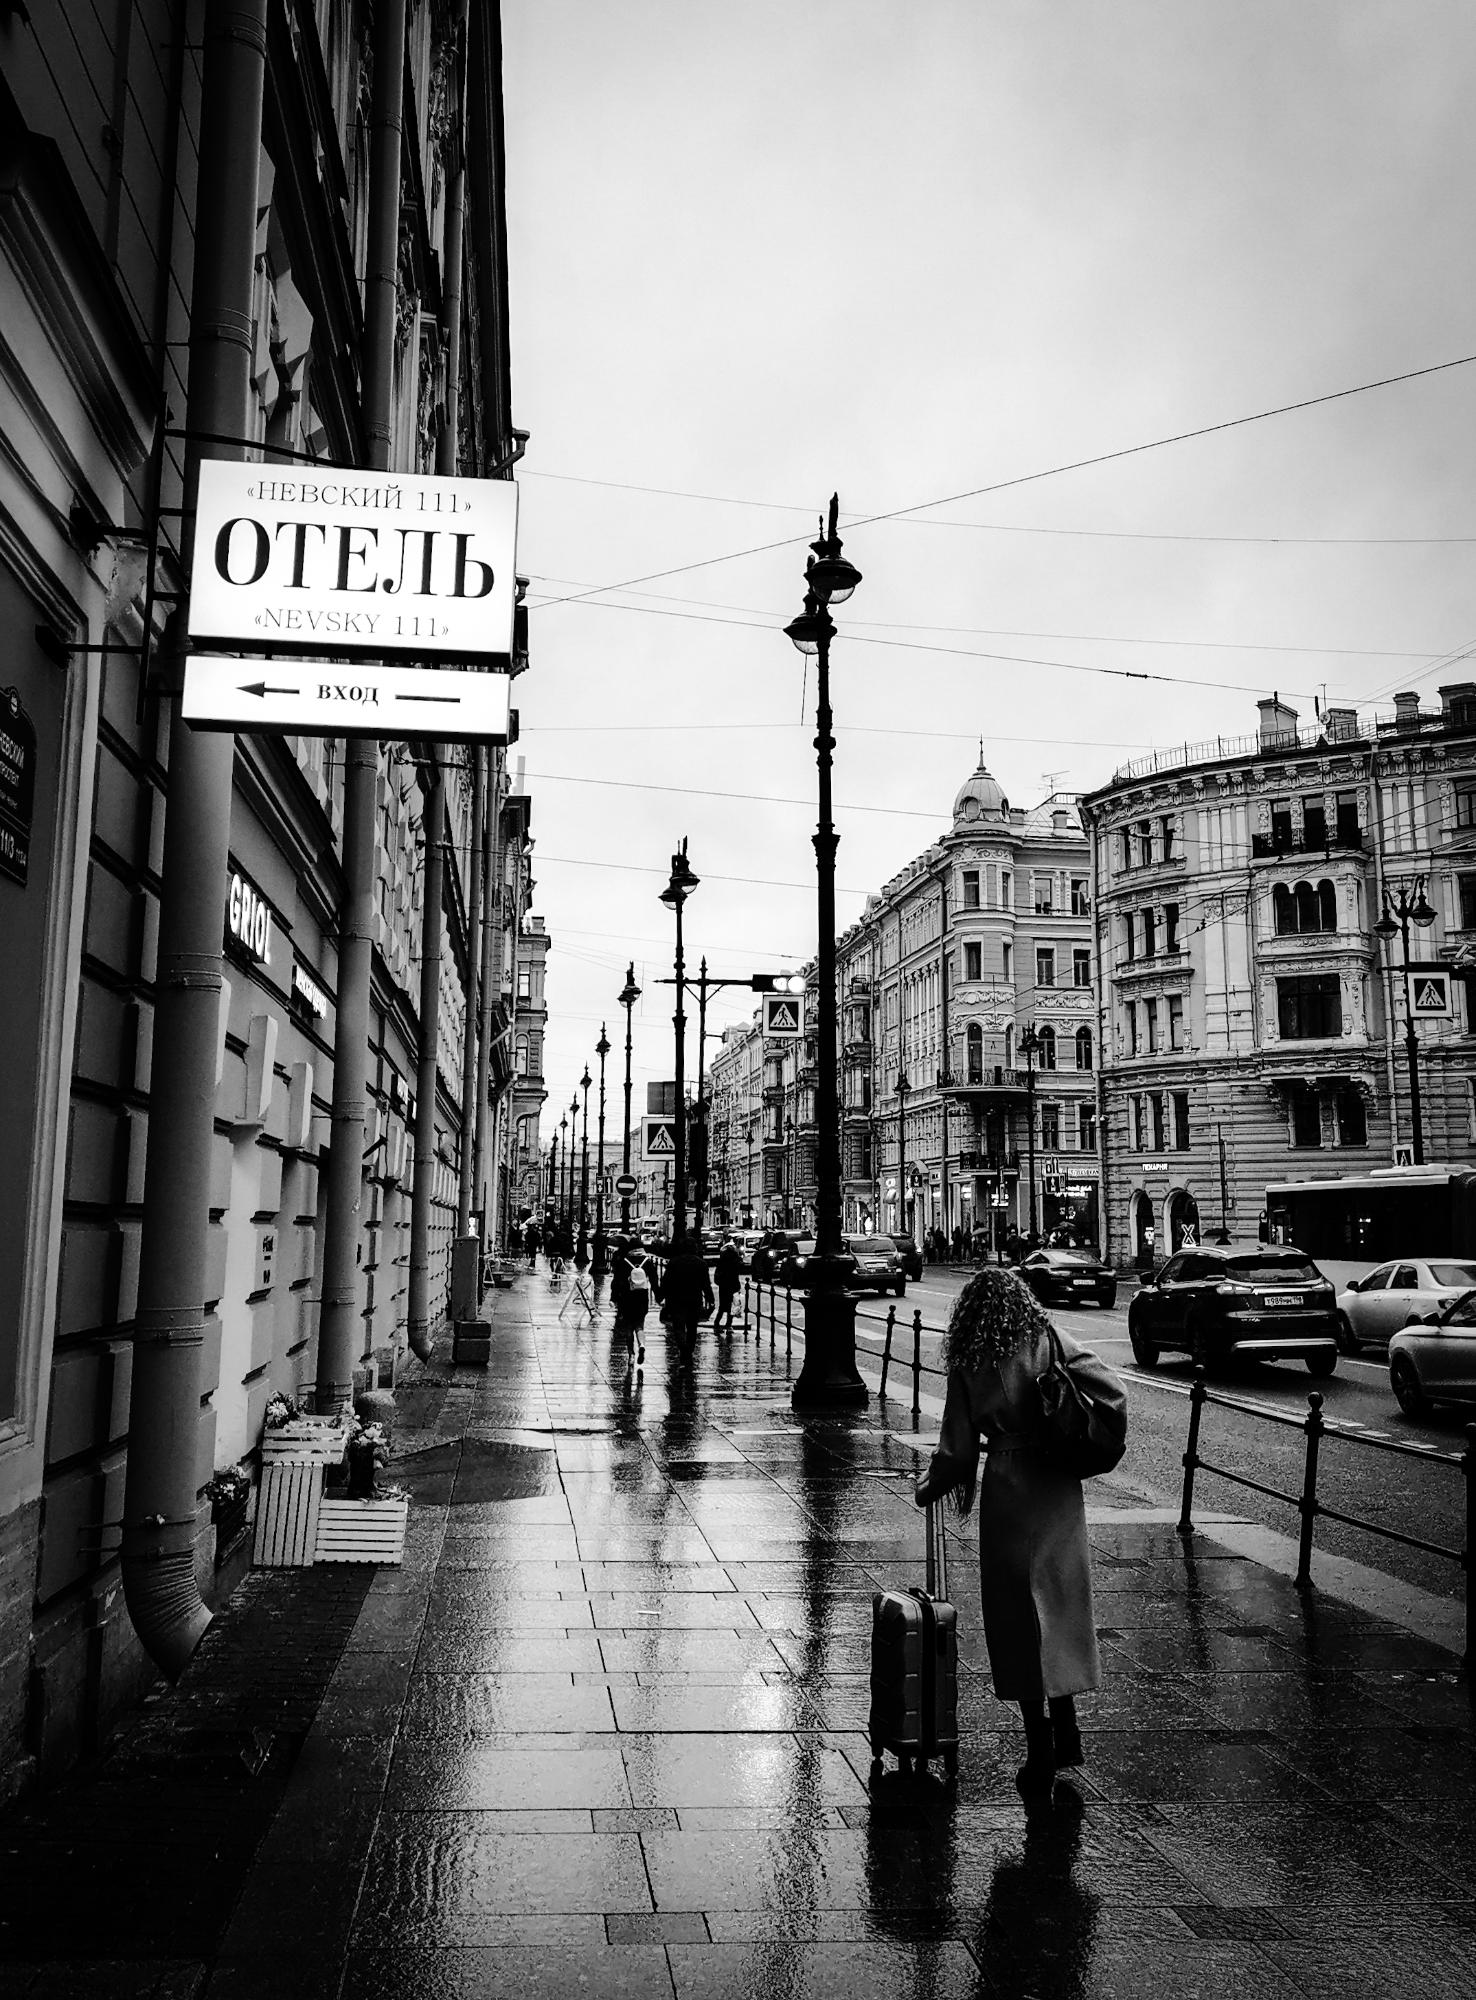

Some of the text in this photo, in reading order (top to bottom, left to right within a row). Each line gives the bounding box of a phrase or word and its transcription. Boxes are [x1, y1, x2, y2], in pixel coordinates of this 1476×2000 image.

[247, 480, 472, 513] «НЕВСКИЙ 111»
[214, 517, 495, 599] ОТЕЛЬ
[254, 608, 449, 637] «NEVSKY 111»
[1142, 1163, 1168, 1171] ПЕКАРНЯ
